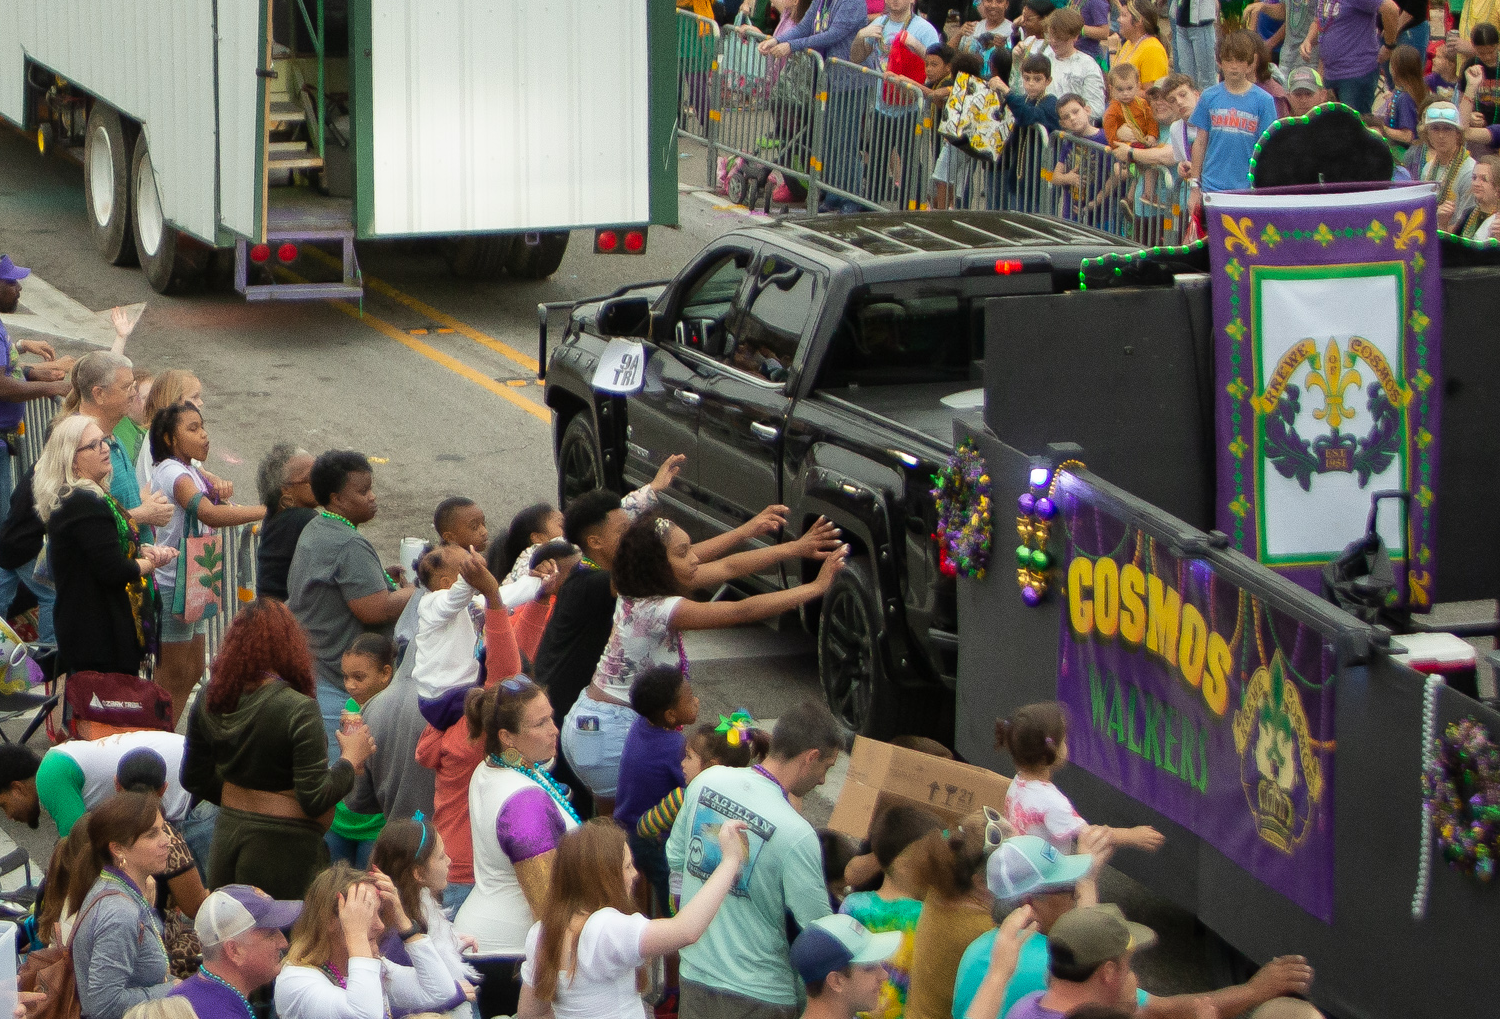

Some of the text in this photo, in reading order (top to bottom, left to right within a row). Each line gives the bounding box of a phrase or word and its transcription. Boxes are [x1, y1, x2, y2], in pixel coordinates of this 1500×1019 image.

[1211, 113, 1259, 133] SAINTS
[620, 353, 640, 371] 9A
[1264, 342, 1309, 407] KREWE
[1328, 355, 1338, 375] OF
[1351, 338, 1401, 403] COSMOS
[1067, 556, 1232, 716] COSMOS
[700, 788, 773, 833] MAGELLAN
